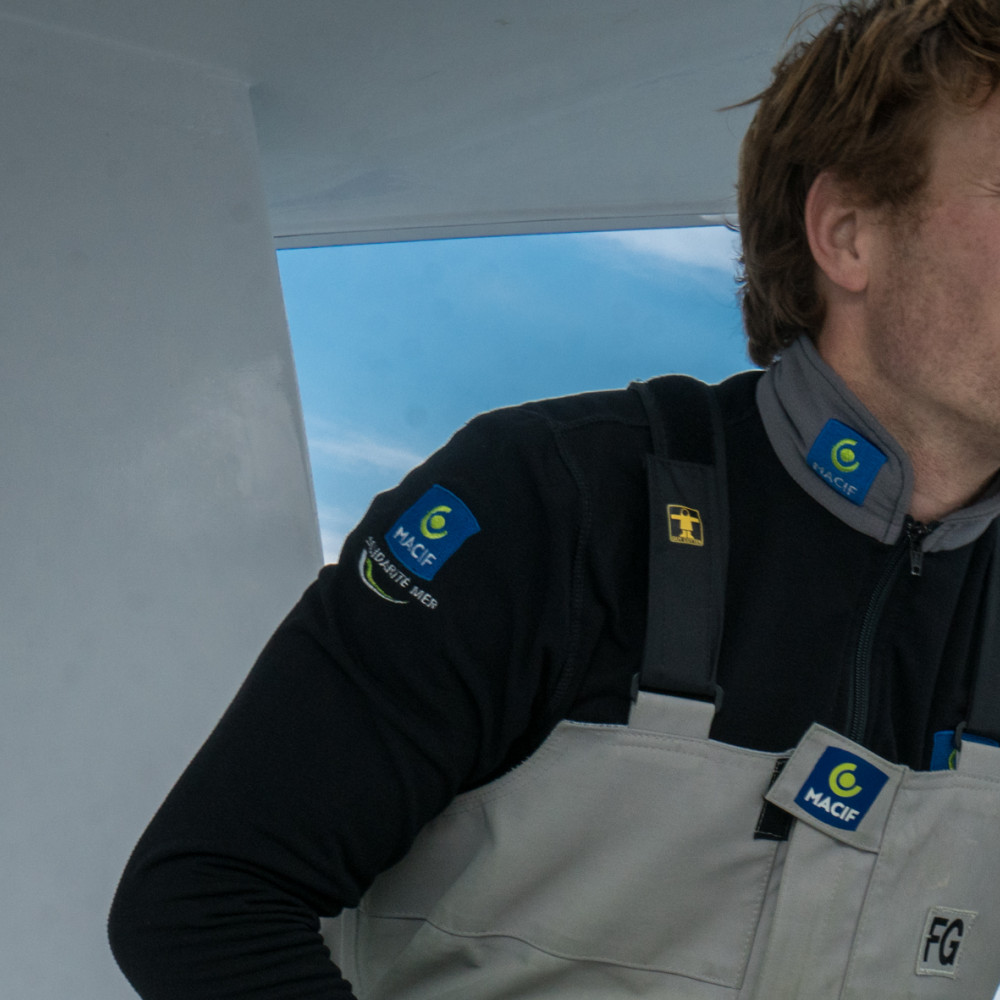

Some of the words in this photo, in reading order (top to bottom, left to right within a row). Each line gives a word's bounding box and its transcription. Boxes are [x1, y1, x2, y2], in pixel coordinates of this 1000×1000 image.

[393, 526, 437, 566] MACIF
[409, 585, 439, 610] MER
[804, 787, 860, 822] MACIF
[923, 916, 964, 966] FG
